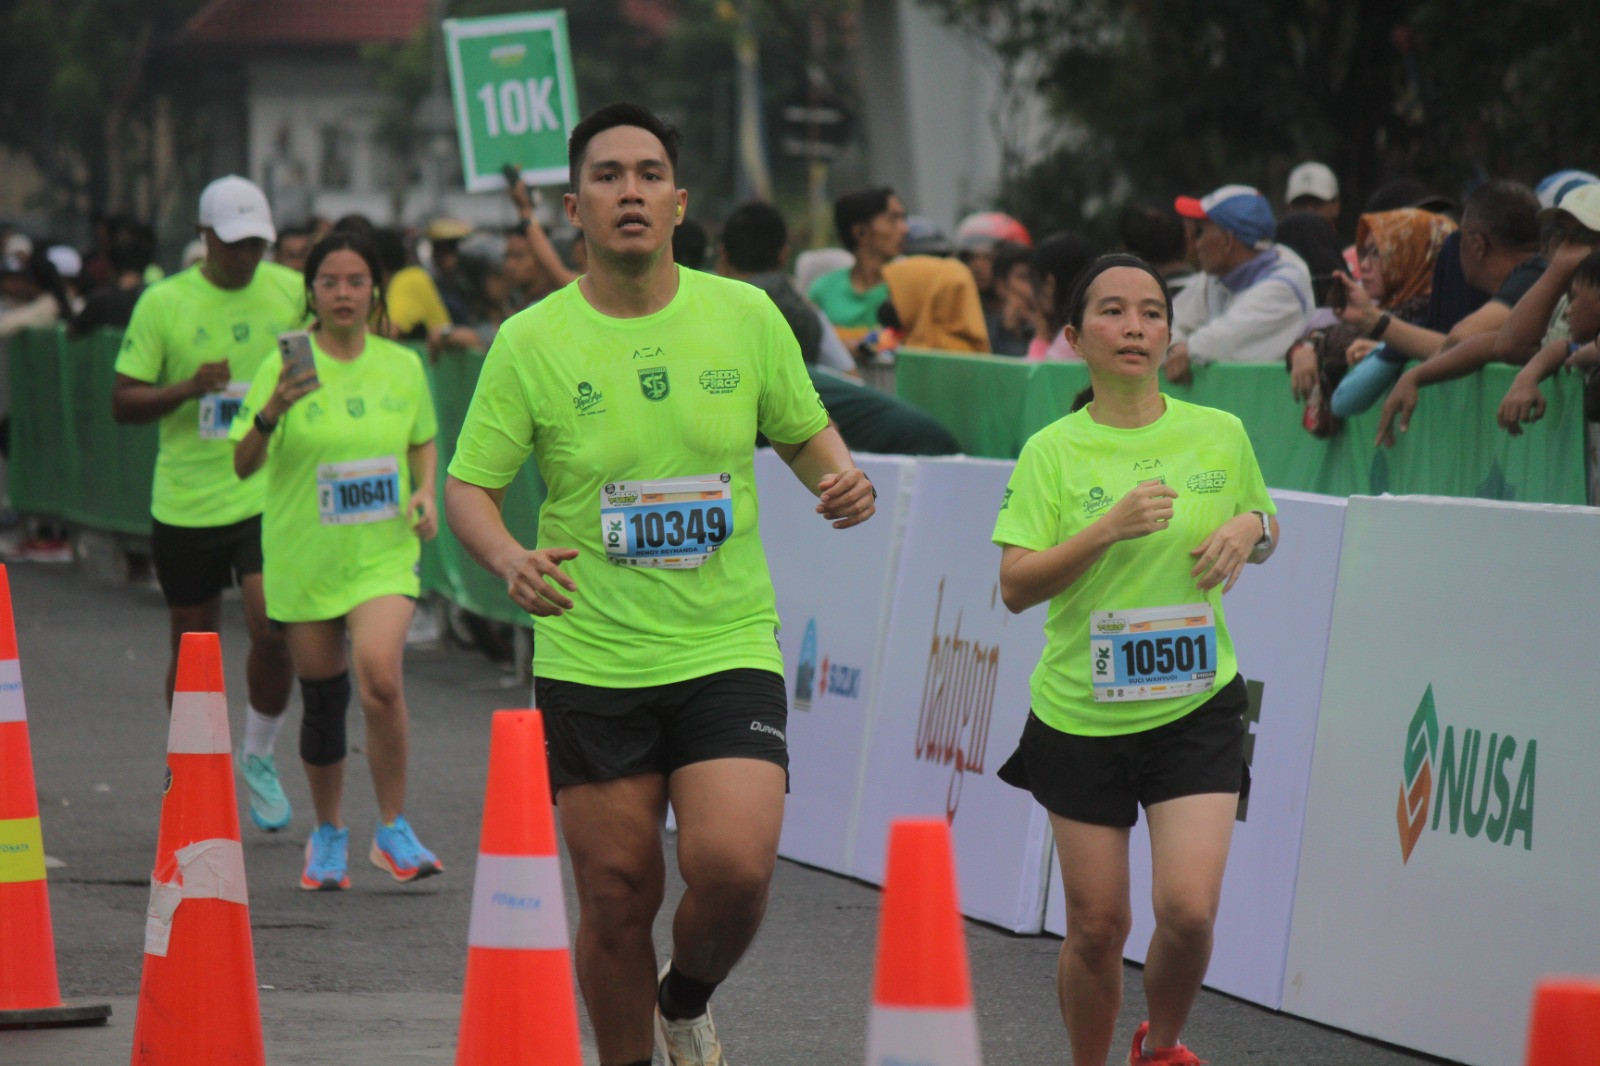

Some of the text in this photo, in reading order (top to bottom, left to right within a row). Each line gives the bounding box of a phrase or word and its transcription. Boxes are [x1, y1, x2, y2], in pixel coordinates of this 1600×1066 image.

[477, 76, 561, 138] 10K
[700, 379, 740, 390] FORCE
[701, 369, 740, 381] GREEN
[1188, 470, 1227, 484] GREEN
[338, 479, 394, 510] 10641
[608, 520, 622, 548] 10K
[630, 507, 727, 549] 10349
[1096, 647, 1110, 676] 10K
[1121, 634, 1208, 677] 10501
[1146, 675, 1178, 683] WAHYUDI
[1432, 725, 1537, 851] NUSA
